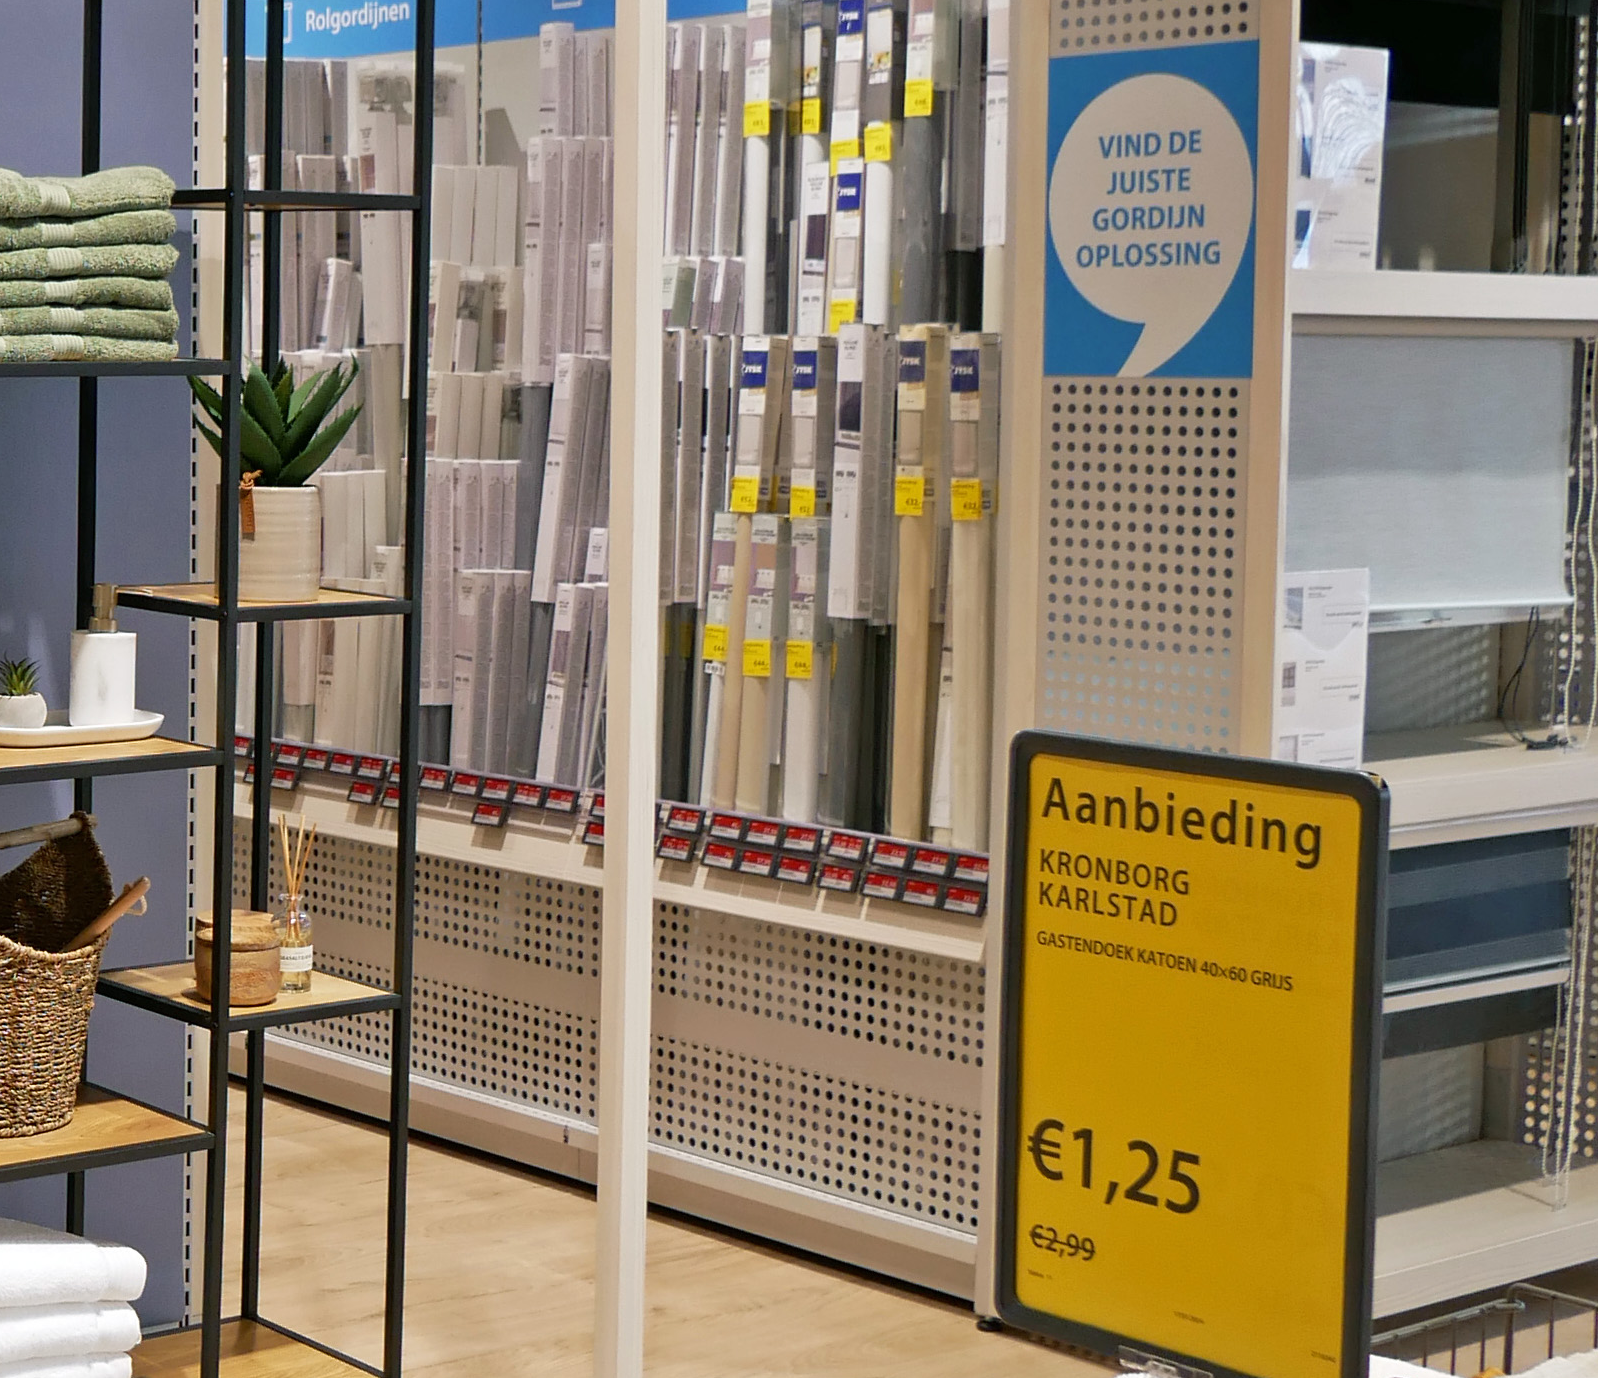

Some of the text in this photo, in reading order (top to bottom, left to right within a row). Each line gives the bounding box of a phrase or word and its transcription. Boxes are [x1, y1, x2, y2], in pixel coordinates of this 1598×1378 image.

[305, 0, 411, 34] Rolgordijnen
[1098, 130, 1202, 159] VIND DE
[1106, 168, 1191, 195] JUISTE
[1092, 204, 1205, 232] GORDIJN
[1076, 240, 1222, 269] OPLOSSING
[1041, 777, 1322, 870] Aanbieding
[1040, 848, 1190, 896] KRONBORG
[1038, 881, 1179, 927] KARLSTAD
[1036, 930, 1135, 962] GASTENDOEK
[1137, 948, 1198, 973] KATOEN
[1250, 969, 1295, 992] GRIJS
[1027, 1119, 1201, 1215] €1,25
[1029, 1223, 1096, 1262] €2,99
